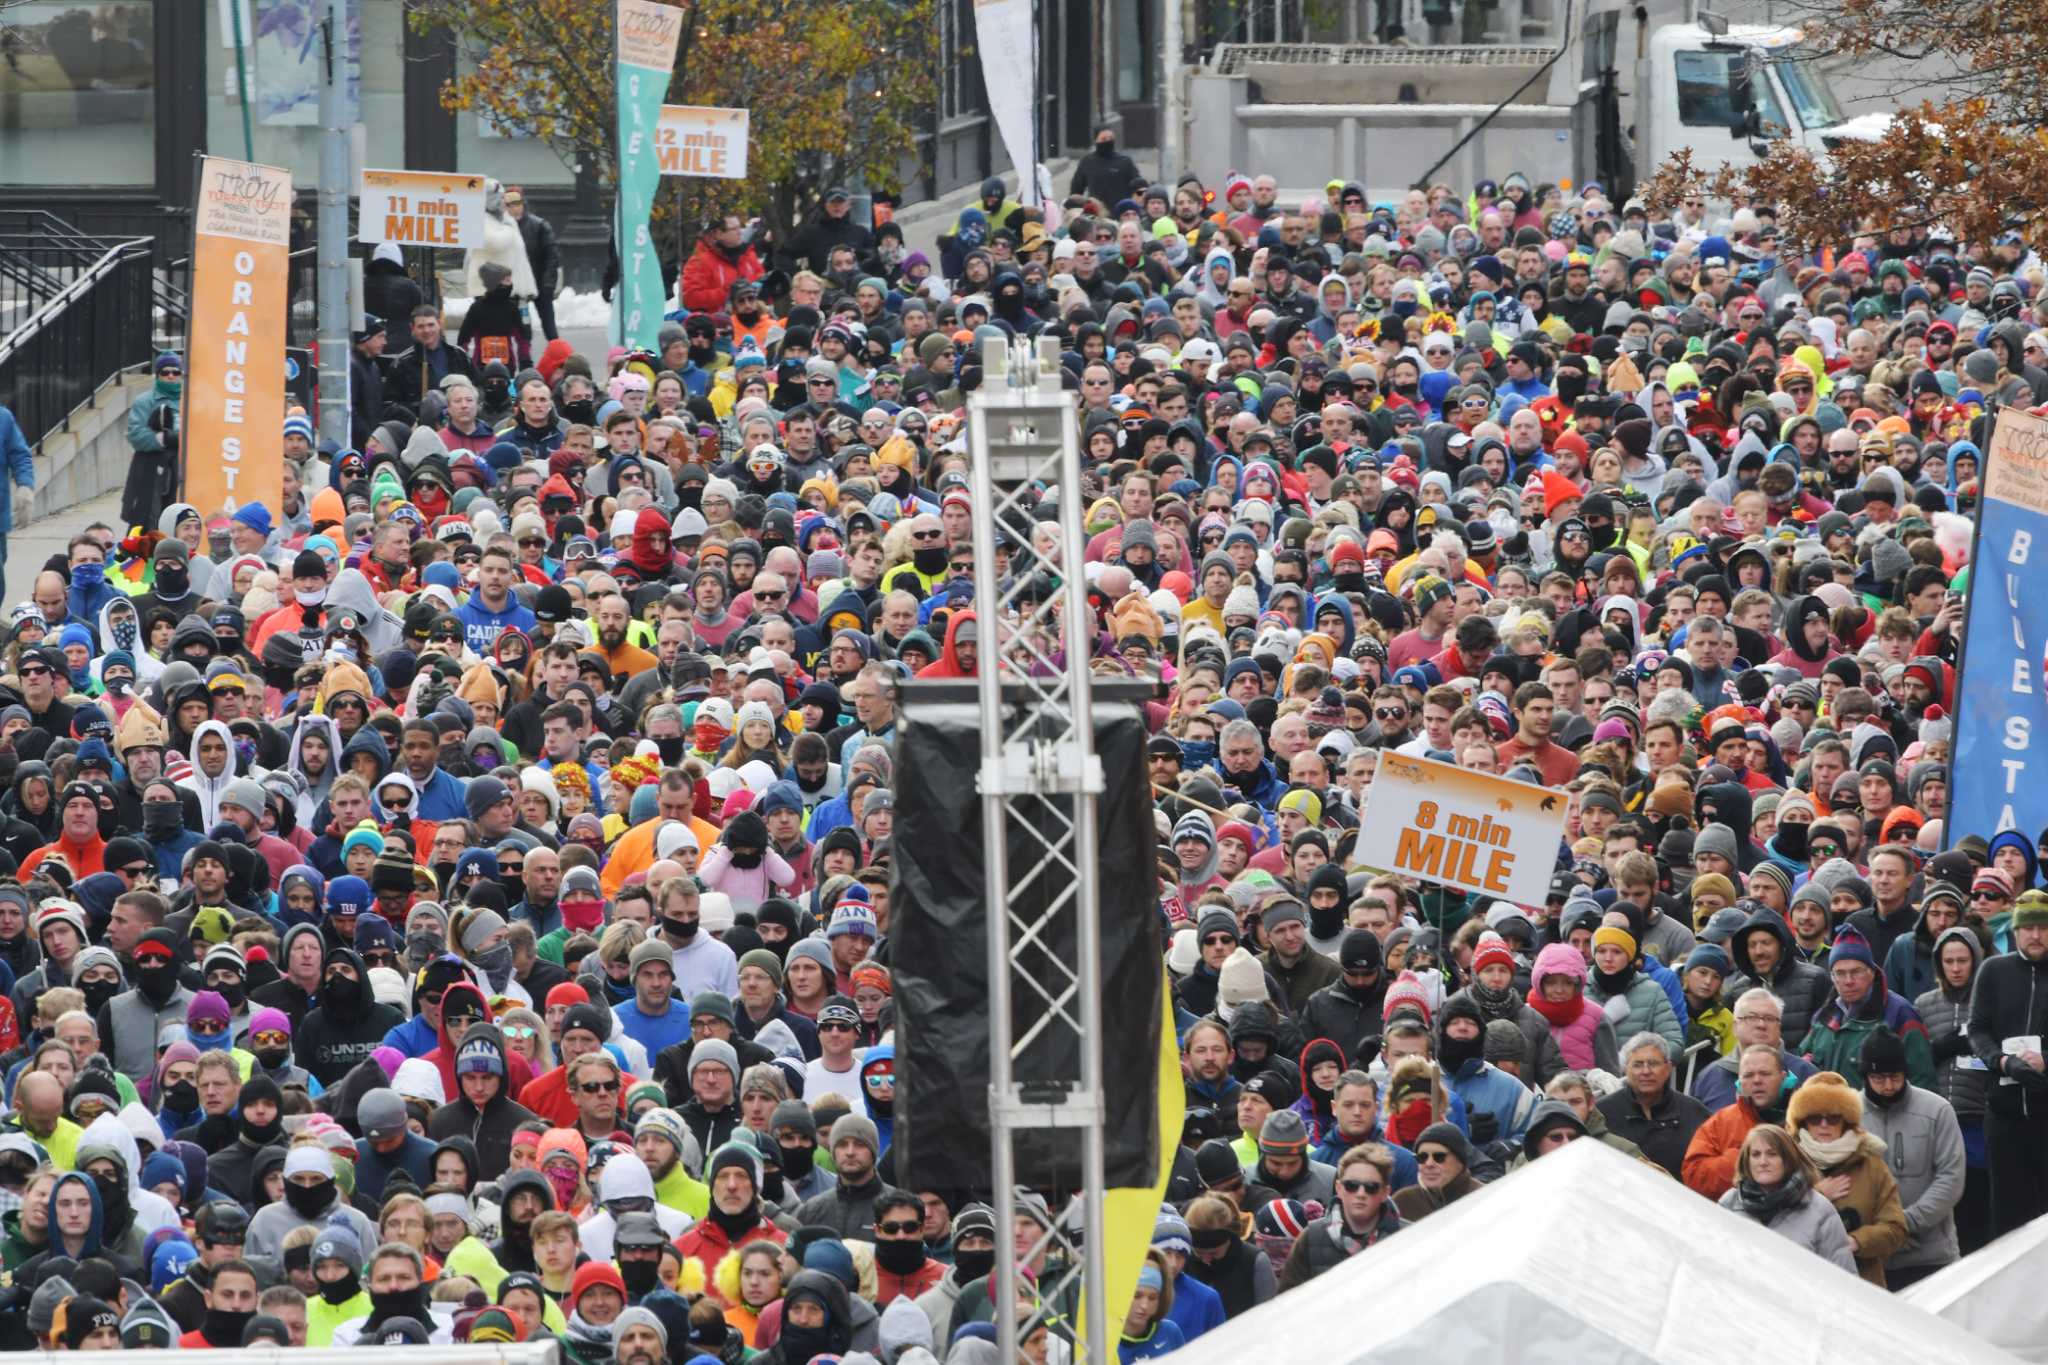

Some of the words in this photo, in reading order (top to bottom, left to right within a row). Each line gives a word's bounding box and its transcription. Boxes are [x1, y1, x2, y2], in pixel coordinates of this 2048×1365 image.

[684, 130, 727, 148] min
[215, 172, 282, 215] TROY
[387, 196, 407, 213] 11
[418, 198, 458, 216] min
[385, 215, 459, 243] MILE
[222, 251, 256, 424] ORANGE
[1415, 800, 1439, 829] 8
[1447, 813, 1511, 848] min
[1394, 827, 1515, 893] MILE
